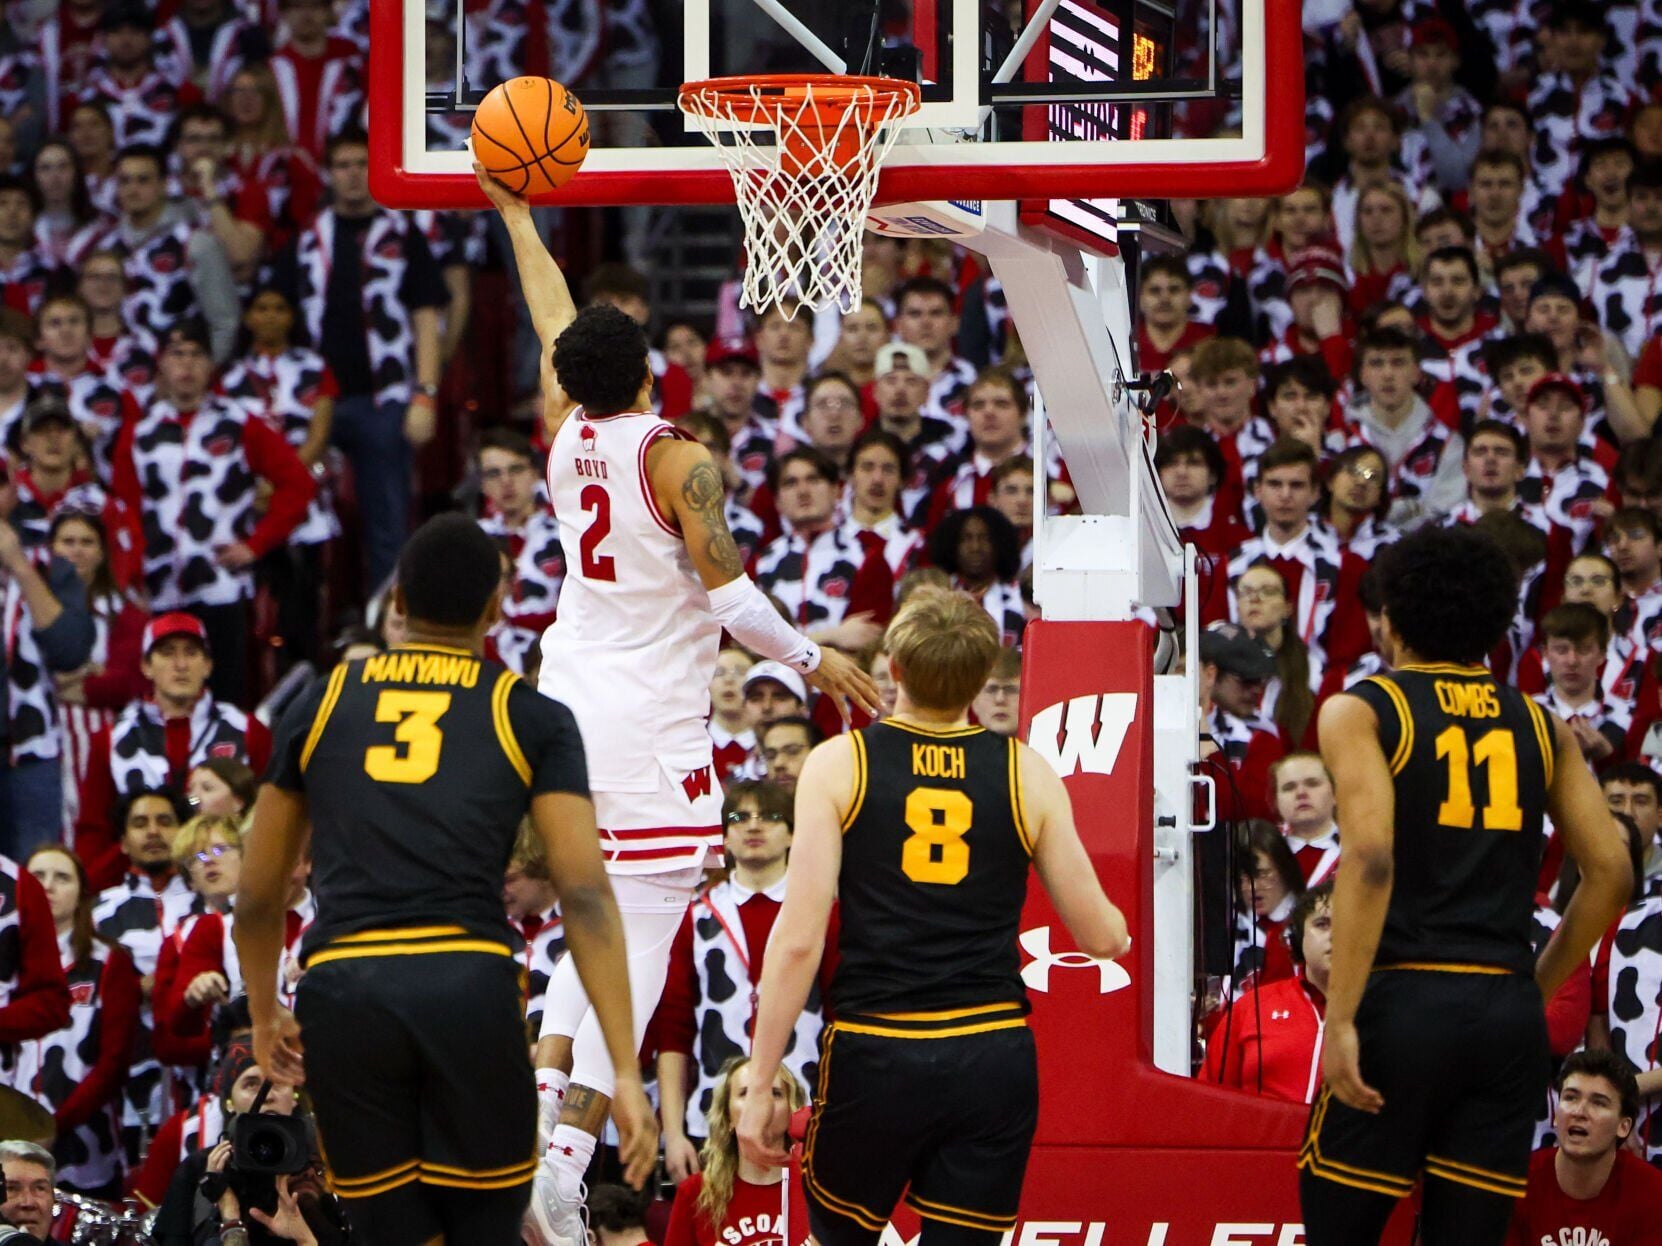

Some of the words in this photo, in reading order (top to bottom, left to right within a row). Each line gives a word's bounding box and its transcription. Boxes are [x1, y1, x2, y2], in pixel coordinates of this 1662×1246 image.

[575, 457, 608, 480] BOYD
[580, 484, 616, 583] 2
[361, 652, 481, 688] MANYAWU
[1434, 677, 1501, 718] COMBS
[364, 689, 452, 784] 3
[912, 742, 966, 779] KOCH
[1027, 692, 1139, 779] W
[681, 764, 711, 804] W
[1435, 724, 1523, 832] 11
[901, 785, 974, 885] 8
